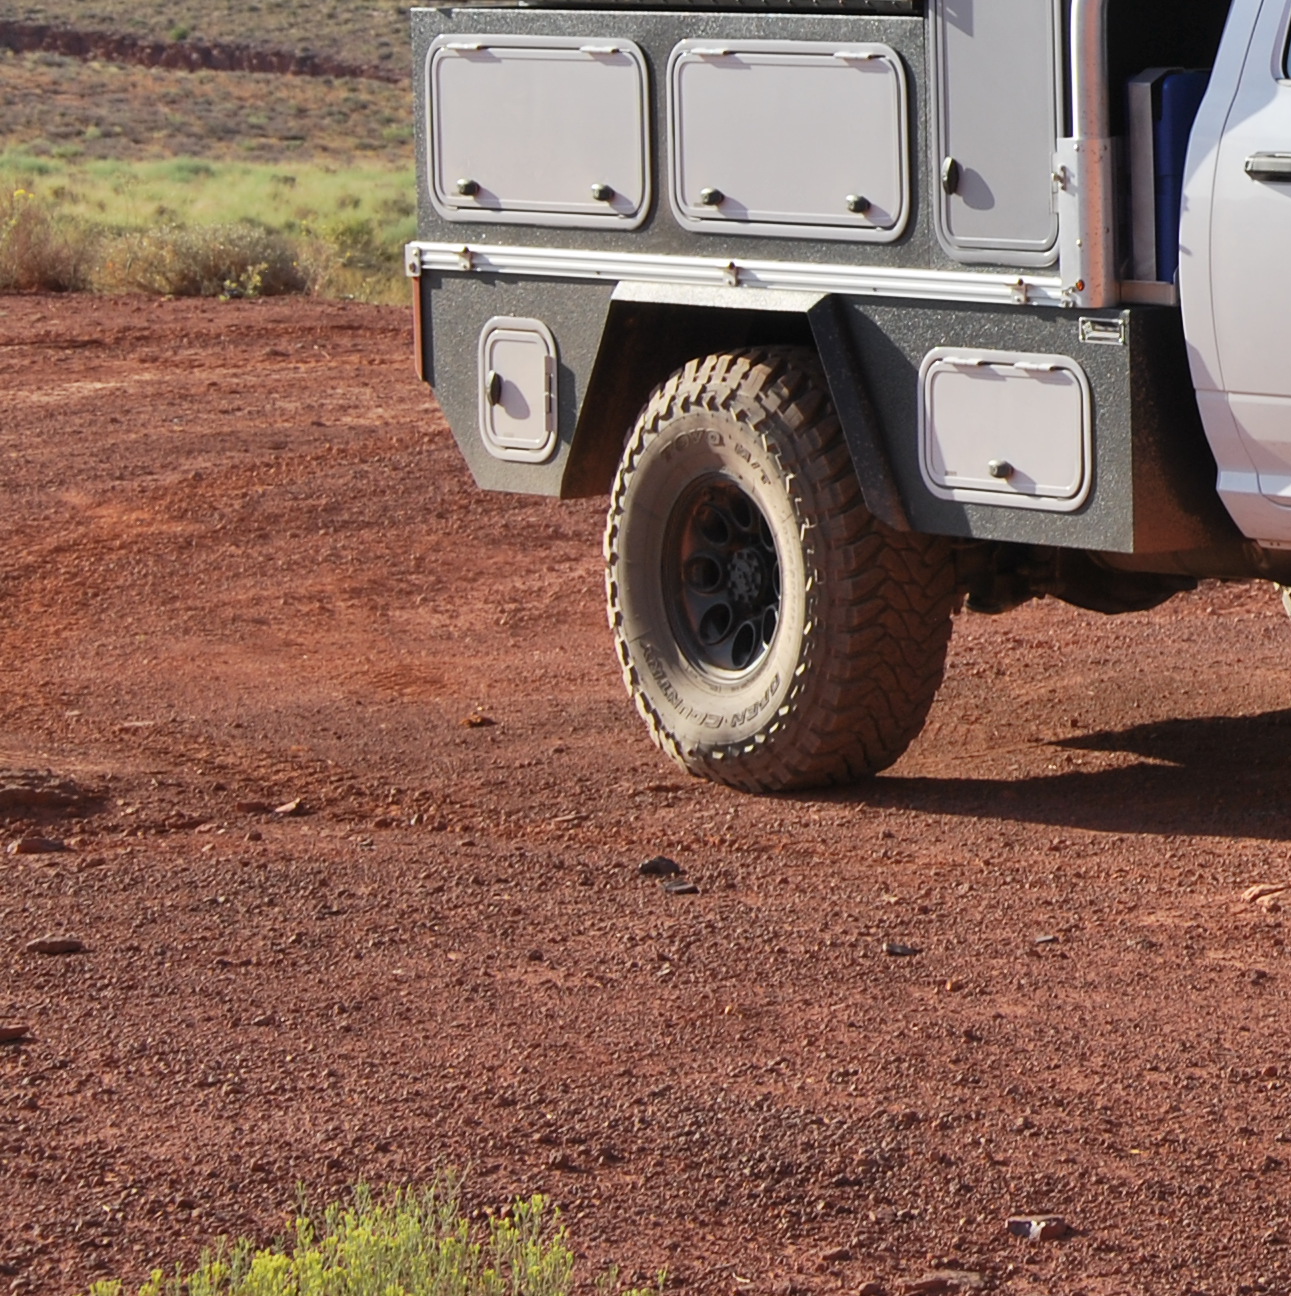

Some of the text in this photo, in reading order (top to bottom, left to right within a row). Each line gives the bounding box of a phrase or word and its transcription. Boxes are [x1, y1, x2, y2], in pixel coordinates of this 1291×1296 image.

[659, 428, 725, 462] TOYO
[639, 640, 781, 730] OPEN COUNTRY
